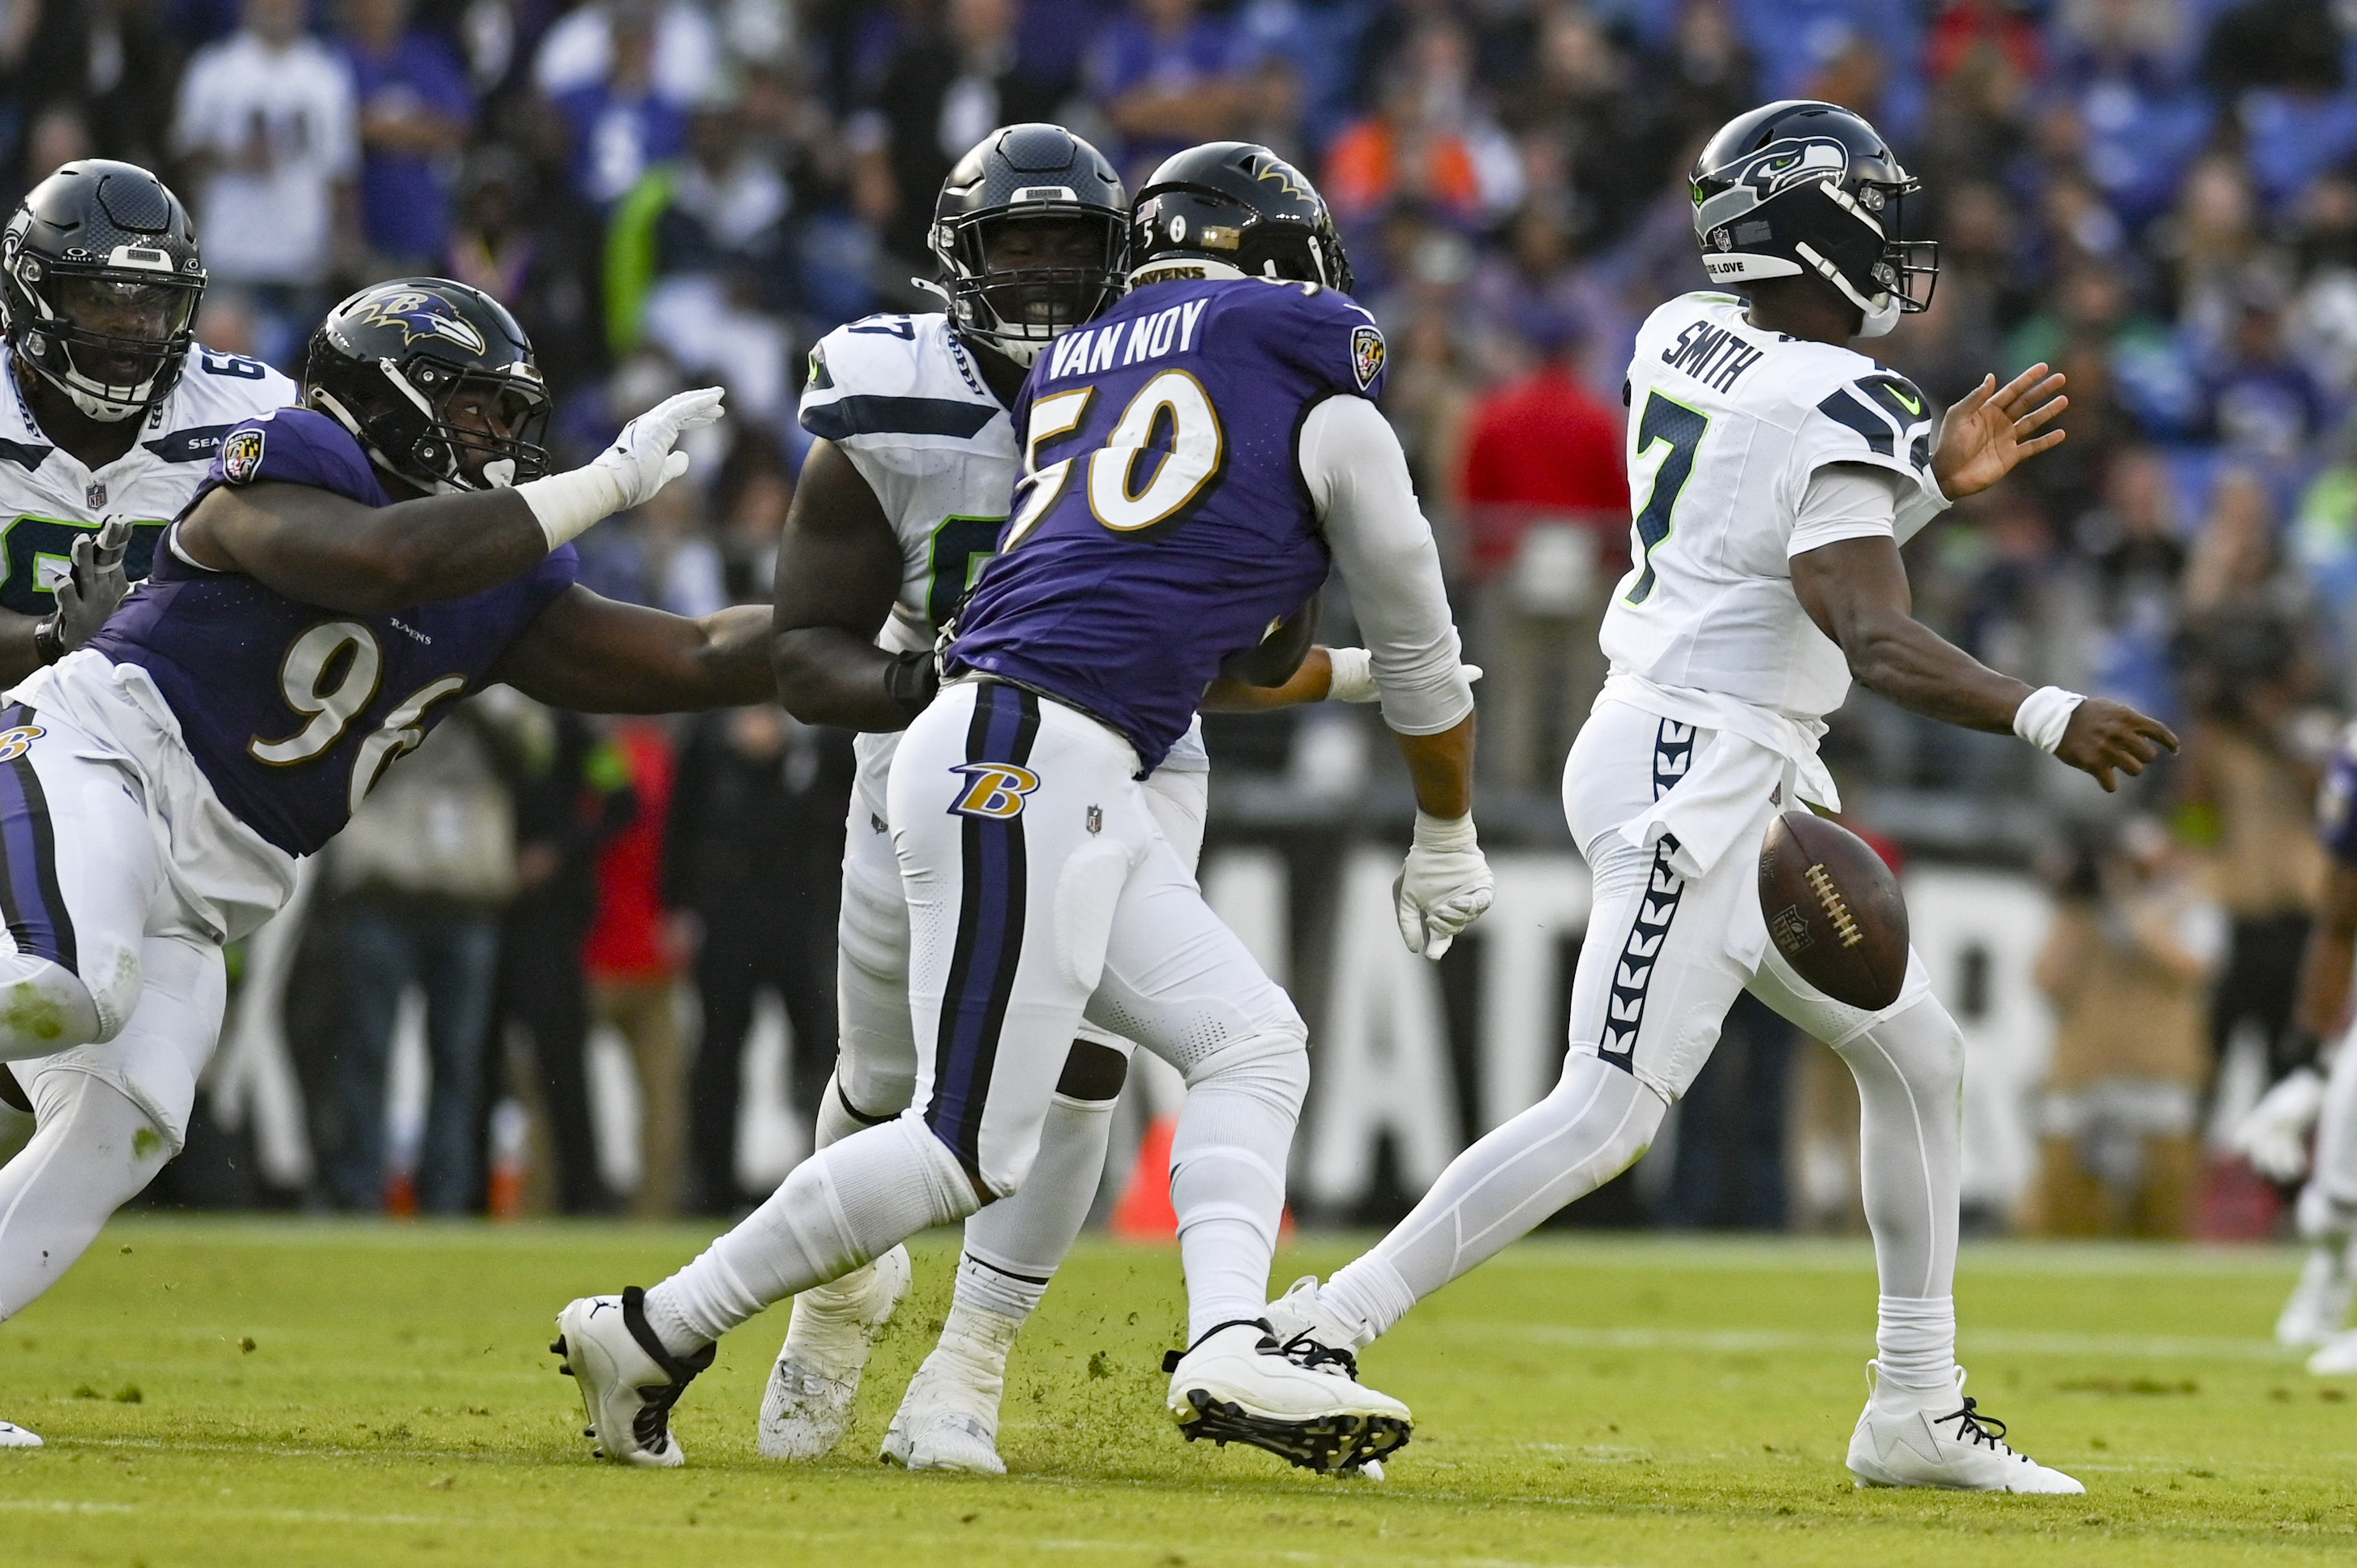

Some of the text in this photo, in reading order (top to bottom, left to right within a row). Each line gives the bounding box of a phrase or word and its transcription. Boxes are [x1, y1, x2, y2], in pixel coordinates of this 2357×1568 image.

[1717, 262, 1744, 273] LOVE
[1050, 322, 1126, 380] VAN
[1123, 298, 1208, 365] NOY
[1662, 319, 1764, 395] SMITH
[1000, 368, 1224, 556] 50
[1623, 386, 1713, 609] 7
[246, 620, 468, 817] 96
[947, 761, 1041, 819] B
